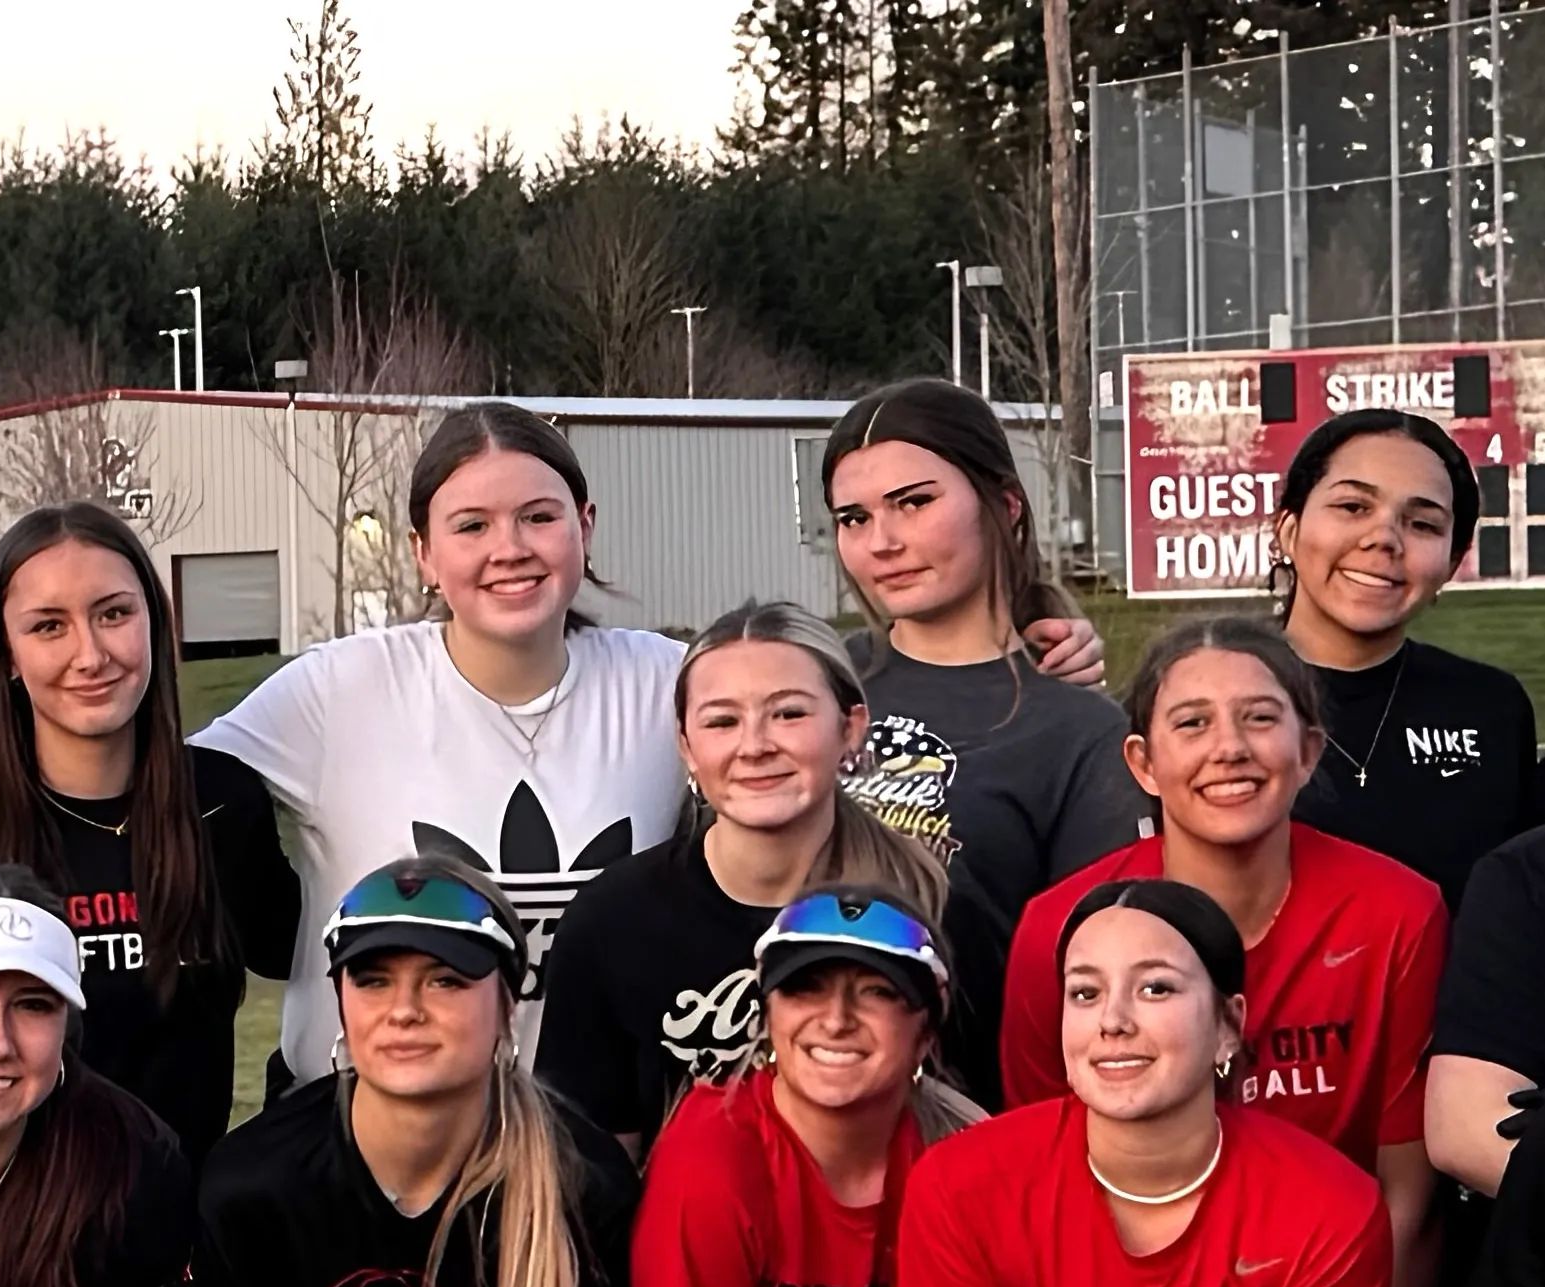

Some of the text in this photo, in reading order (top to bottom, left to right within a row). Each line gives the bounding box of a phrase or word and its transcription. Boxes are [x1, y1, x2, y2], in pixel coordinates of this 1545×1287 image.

[1170, 377, 1261, 416] BALL
[1326, 370, 1455, 412] STRIKE
[1486, 433, 1503, 463] 4
[1149, 472, 1281, 520] GUEST
[1405, 726, 1481, 757] NIKE
